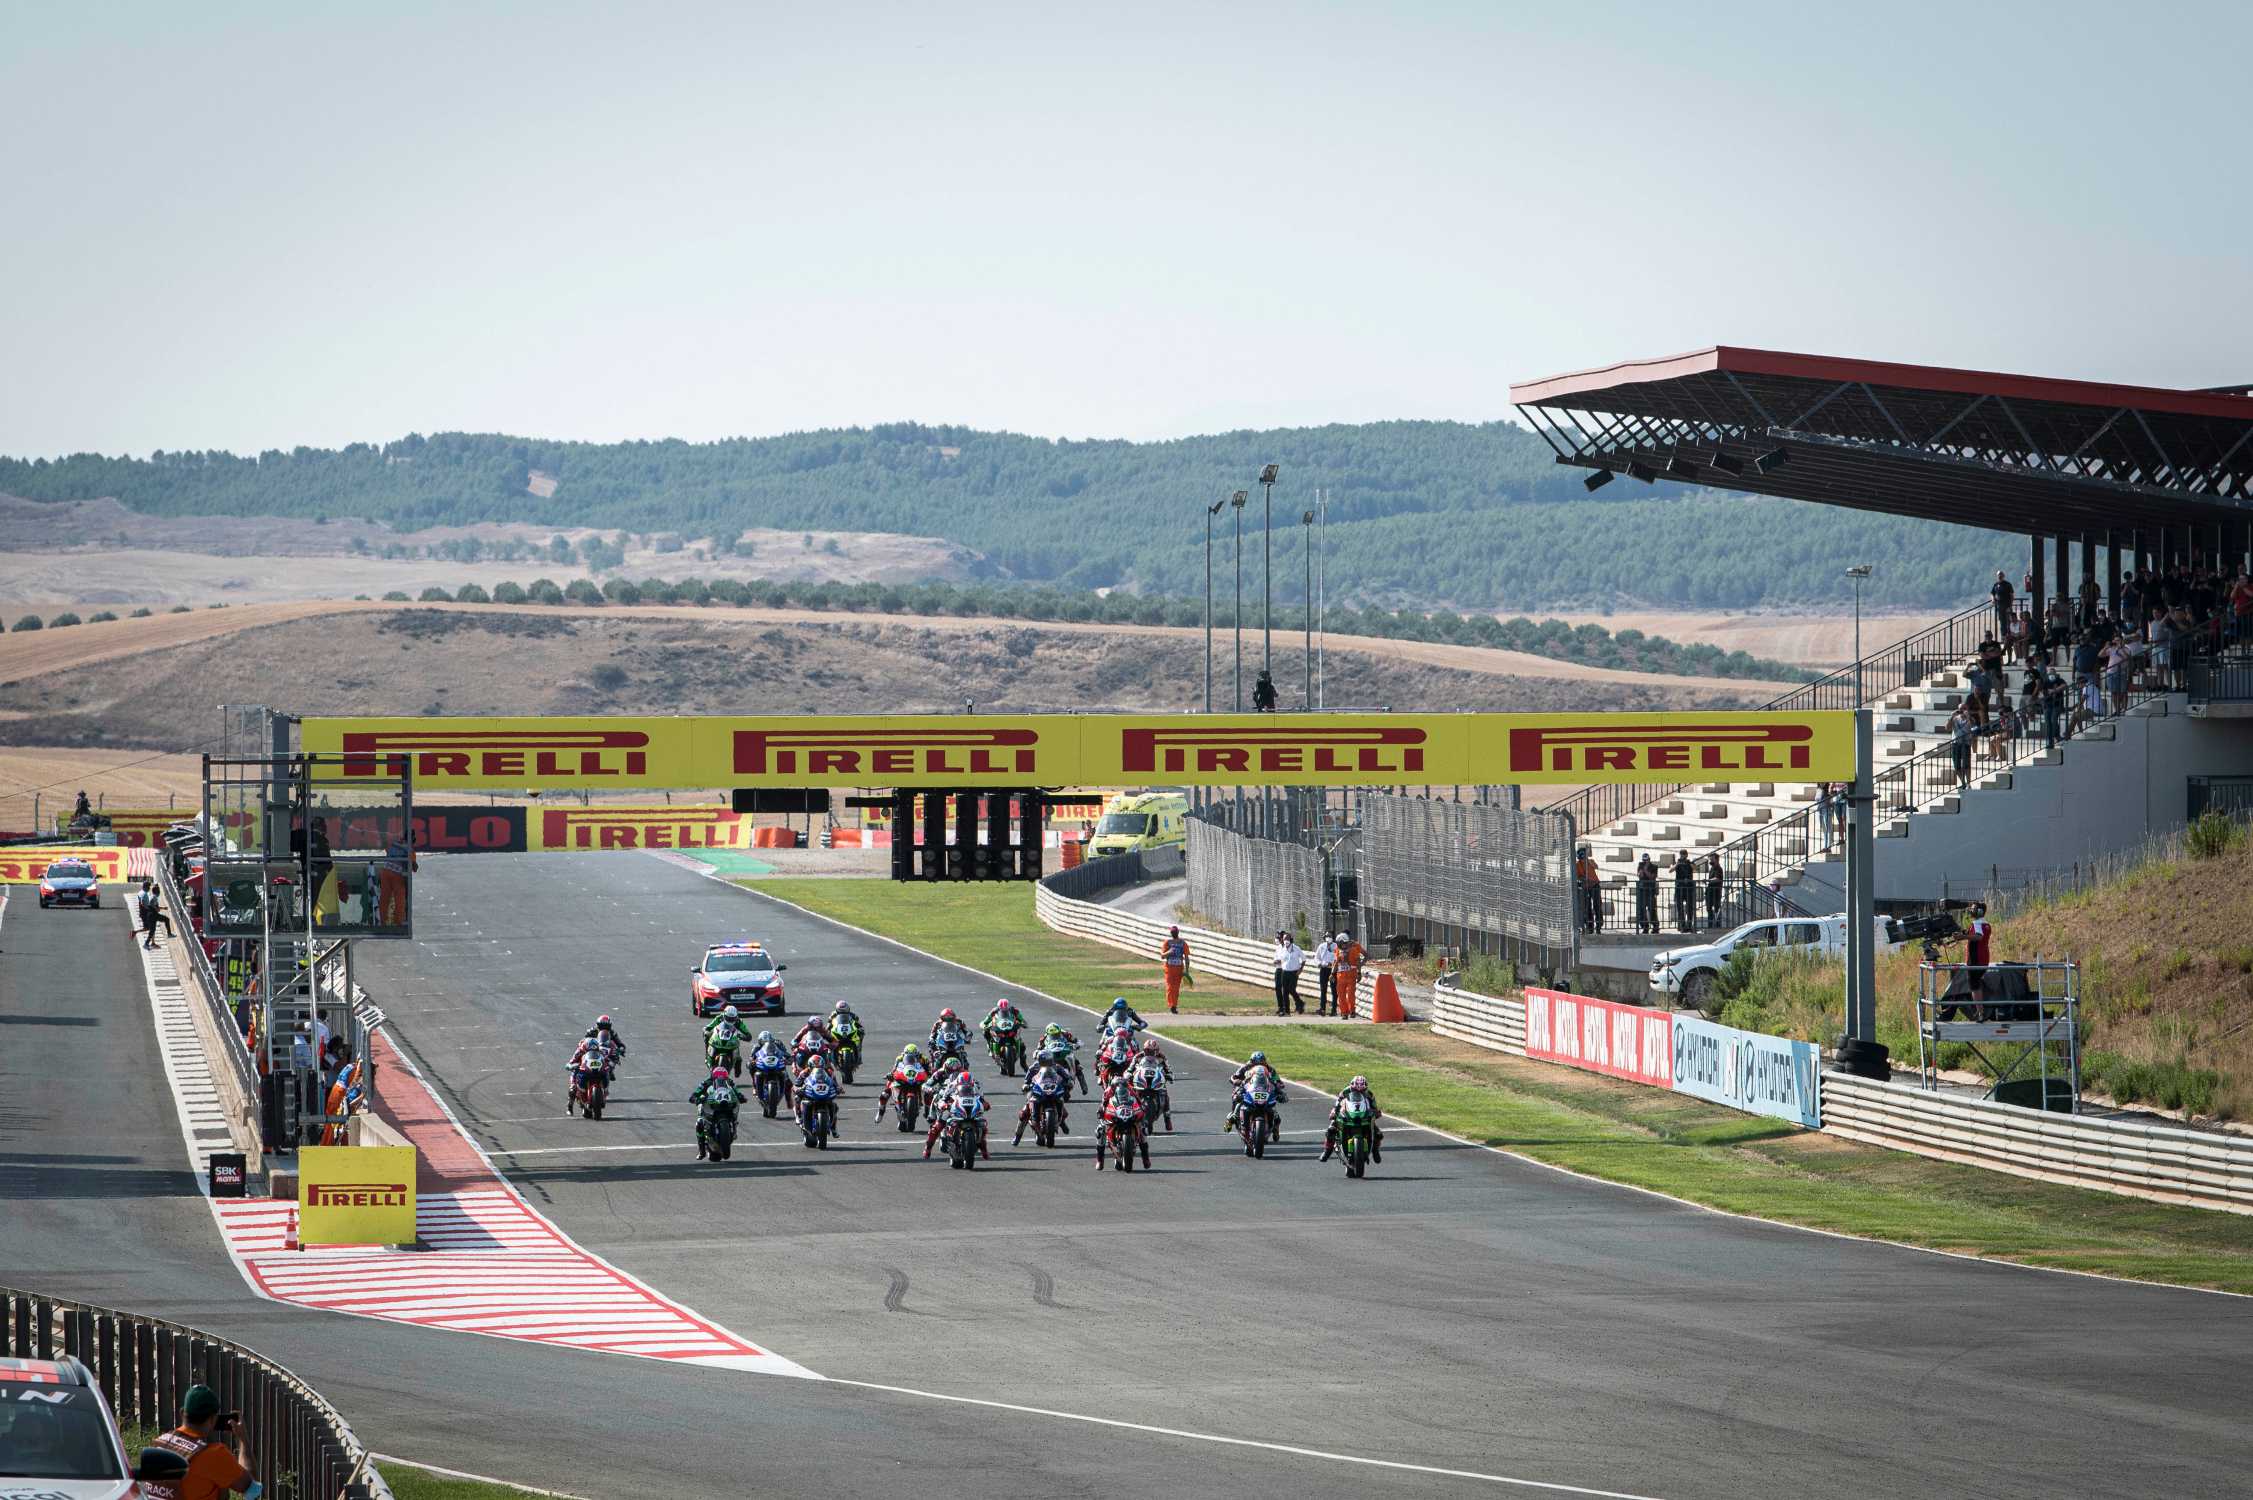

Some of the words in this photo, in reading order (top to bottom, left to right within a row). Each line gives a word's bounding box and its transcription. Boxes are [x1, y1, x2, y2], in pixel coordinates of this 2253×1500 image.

[343, 731, 649, 776] PIRELLI
[733, 729, 1039, 774] PIRELLI
[1122, 727, 1428, 772] PIRELLI
[1510, 725, 1813, 771] PIRELLI
[292, 815, 512, 848] IABLO
[543, 809, 742, 849] PIRELLI
[1528, 994, 1550, 1053] MOTUL
[1555, 999, 1579, 1059] MOTUL
[1583, 1005, 1608, 1066] MOTUL
[1613, 1010, 1638, 1073] MOTUL
[1643, 1016, 1670, 1080] MOTUL
[1687, 1032, 1720, 1088] HYUNDAI
[1757, 1049, 1796, 1106] HYUNDAI
[215, 1166, 237, 1176] SBK
[307, 1183, 408, 1207] PIRELLI
